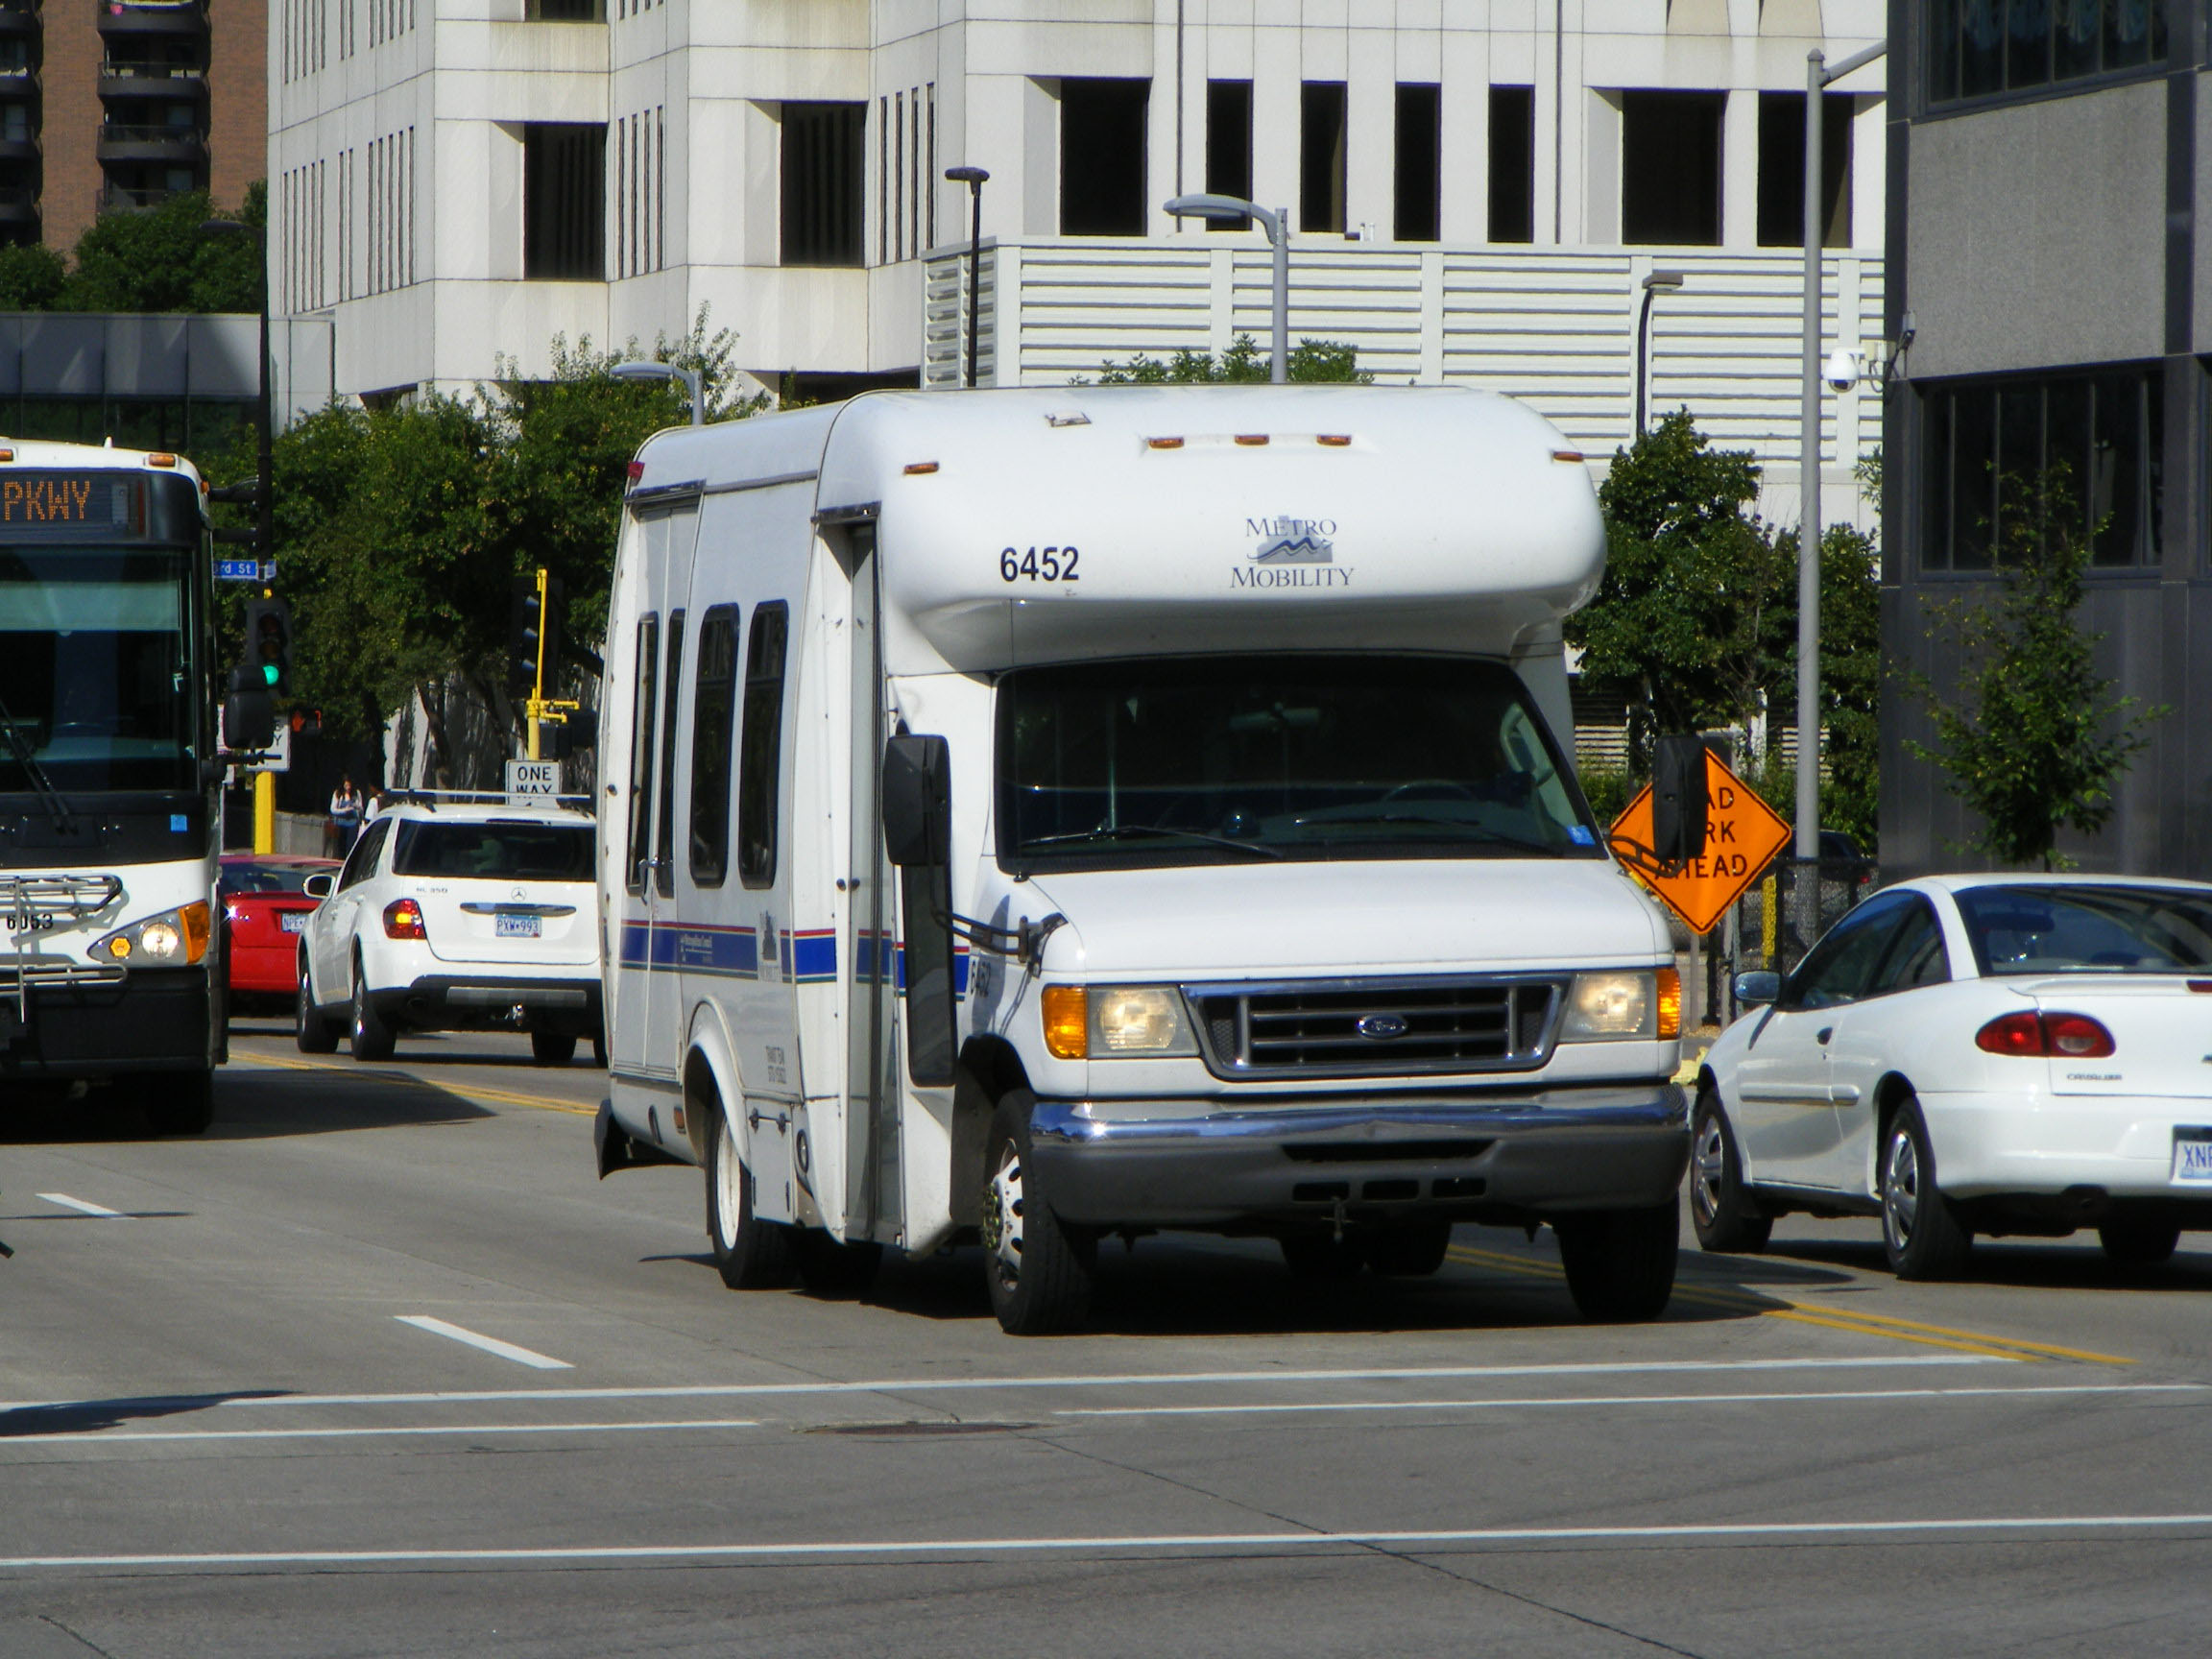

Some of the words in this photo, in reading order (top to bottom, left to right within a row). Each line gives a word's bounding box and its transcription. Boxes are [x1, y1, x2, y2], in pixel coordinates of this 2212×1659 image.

[4, 480, 90, 520] PKWY
[1246, 517, 1337, 537] METRO
[238, 563, 252, 574] St
[999, 545, 1080, 582] 6452
[1230, 566, 1354, 588] MOBILITY
[517, 765, 552, 781] ONE
[1705, 820, 1736, 844] RK
[7, 913, 54, 930] 6053
